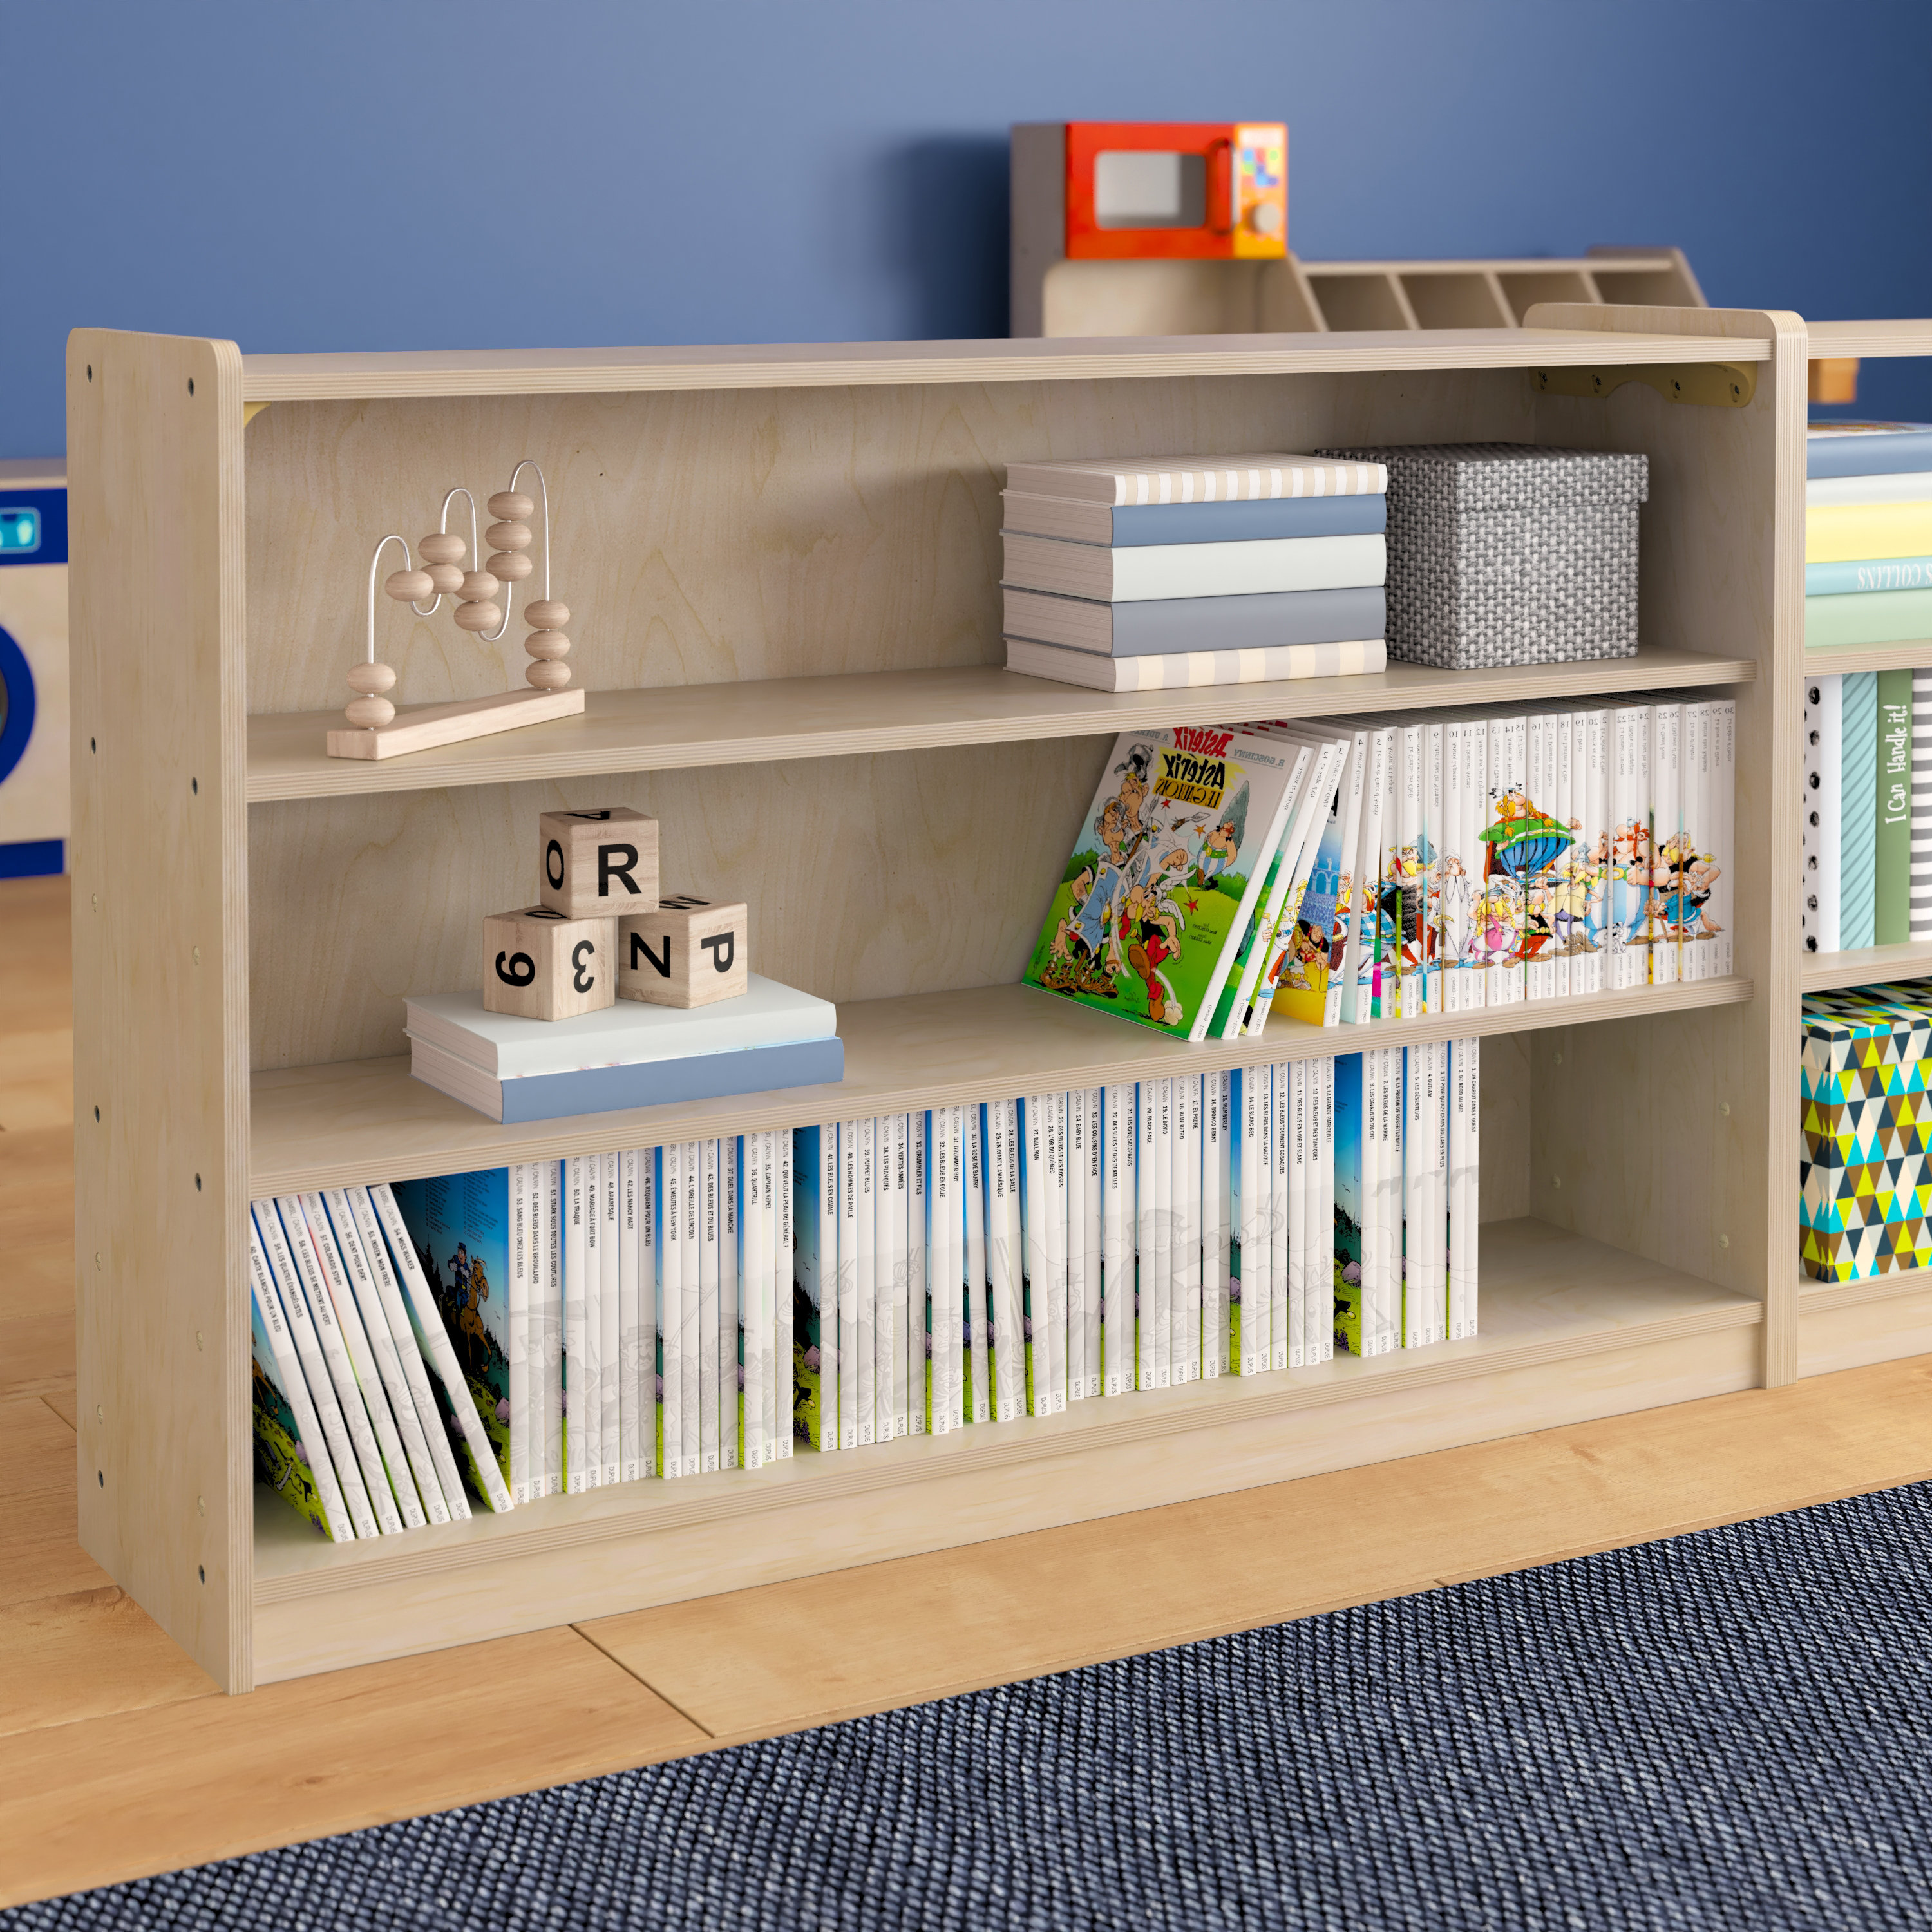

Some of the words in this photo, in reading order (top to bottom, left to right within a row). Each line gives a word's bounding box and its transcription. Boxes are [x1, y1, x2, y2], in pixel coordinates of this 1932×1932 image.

[1857, 564, 1922, 590] COLLINS
[1882, 705, 1908, 723] it!
[1885, 726, 1908, 773] Handle
[1887, 783, 1907, 811] Can
[1885, 814, 1907, 824] I
[598, 843, 642, 897] R
[701, 931, 734, 974] P
